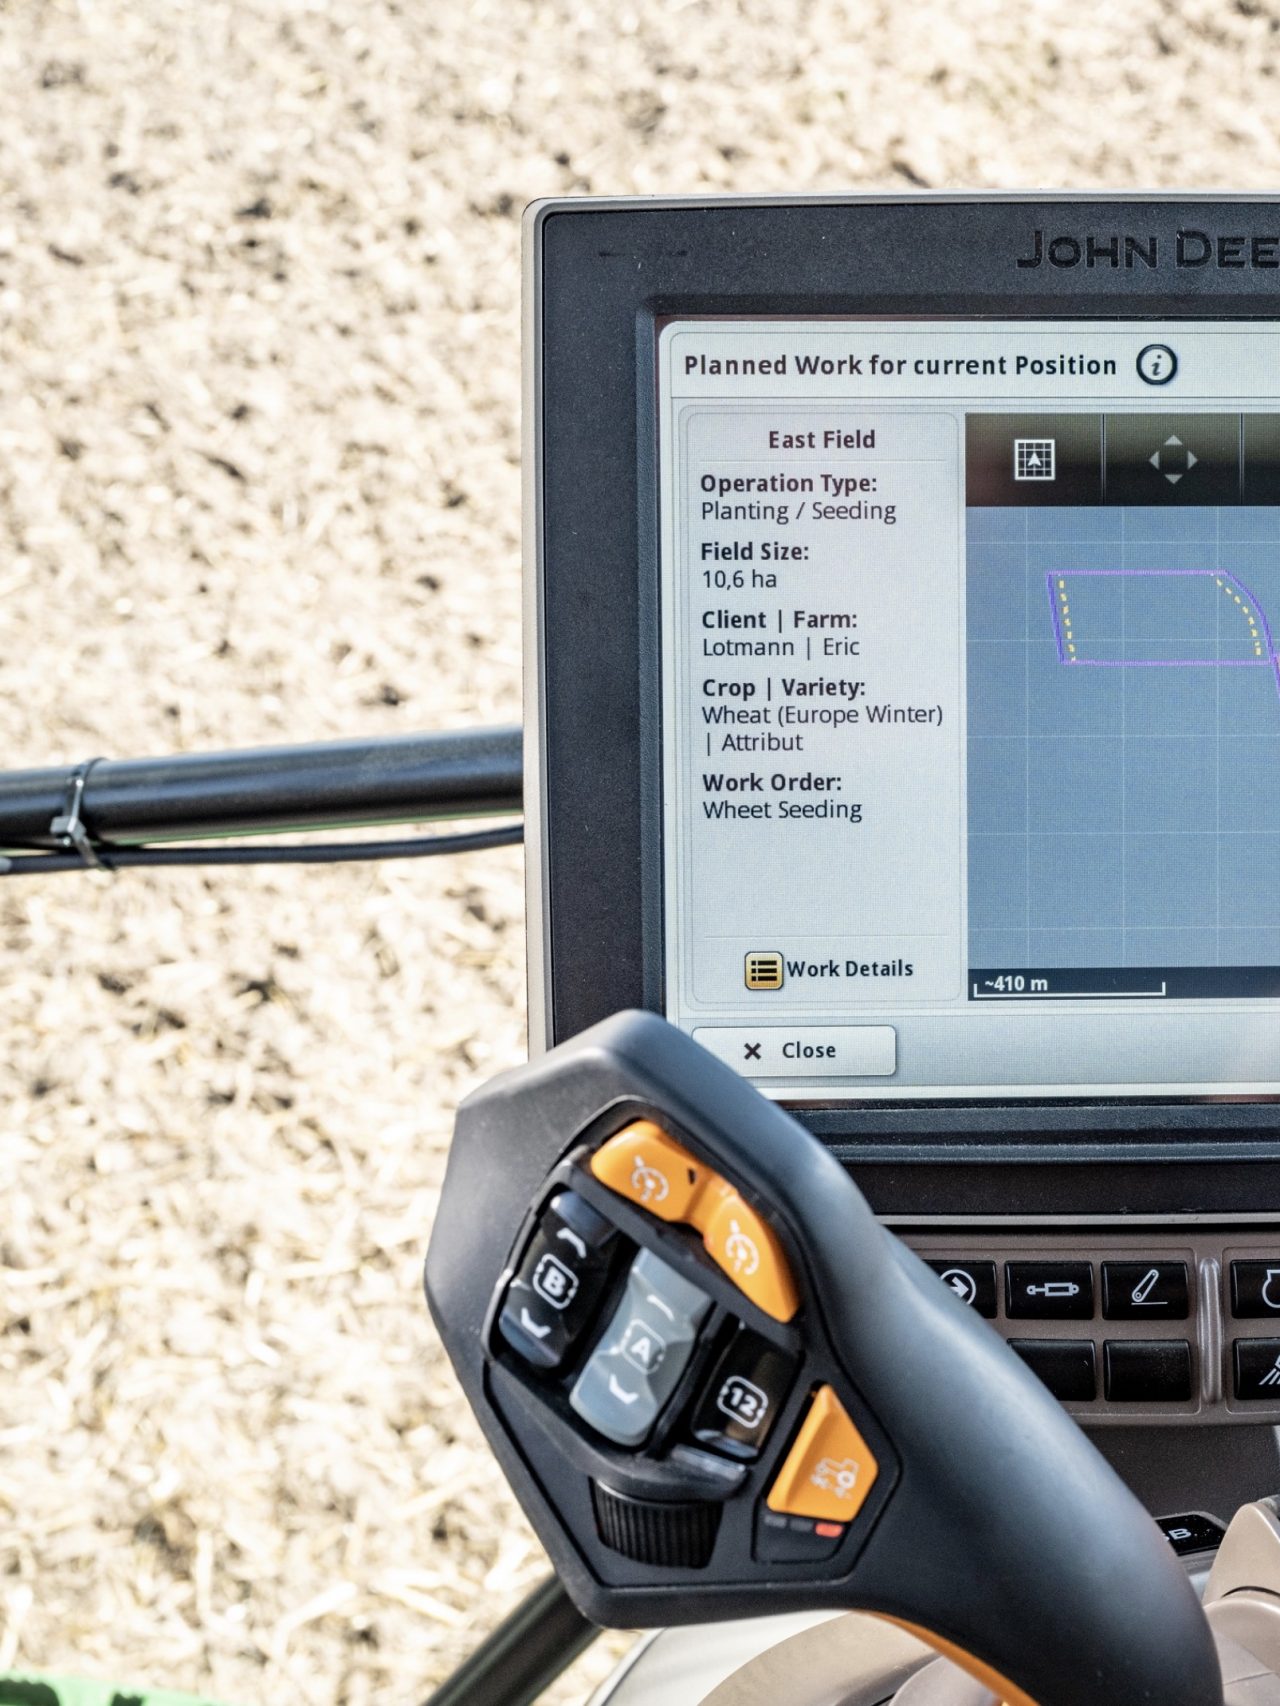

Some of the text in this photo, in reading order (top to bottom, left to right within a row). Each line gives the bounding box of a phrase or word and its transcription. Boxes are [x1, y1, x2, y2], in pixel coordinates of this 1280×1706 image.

[1016, 229, 1159, 269] JOHN
[685, 354, 1116, 375] Planned Work for current Position
[769, 429, 876, 449] East Field
[700, 473, 877, 498] Operation Type:
[702, 500, 789, 525] Planting
[812, 500, 897, 525] Seeding
[701, 541, 809, 561] Field Size:
[703, 568, 777, 591] 10,6 ha
[702, 609, 767, 629] Client
[793, 610, 857, 629] Farm:
[703, 638, 794, 657] Lotmann
[823, 636, 860, 656] Eric
[702, 678, 756, 702] Crop
[781, 676, 865, 701] Variety:
[701, 703, 943, 729] Wheat (Europe Winter)
[721, 732, 804, 752] Attribut
[702, 772, 842, 792] Work Order:
[702, 799, 863, 824] Wheet Seeding
[786, 958, 914, 978] Work Details
[984, 975, 1048, 992] ~410 m
[782, 1040, 836, 1059] Close
[542, 1266, 565, 1297] B
[631, 1337, 652, 1364] A
[729, 1387, 757, 1416] 12
[1162, 1528, 1192, 1540] B
